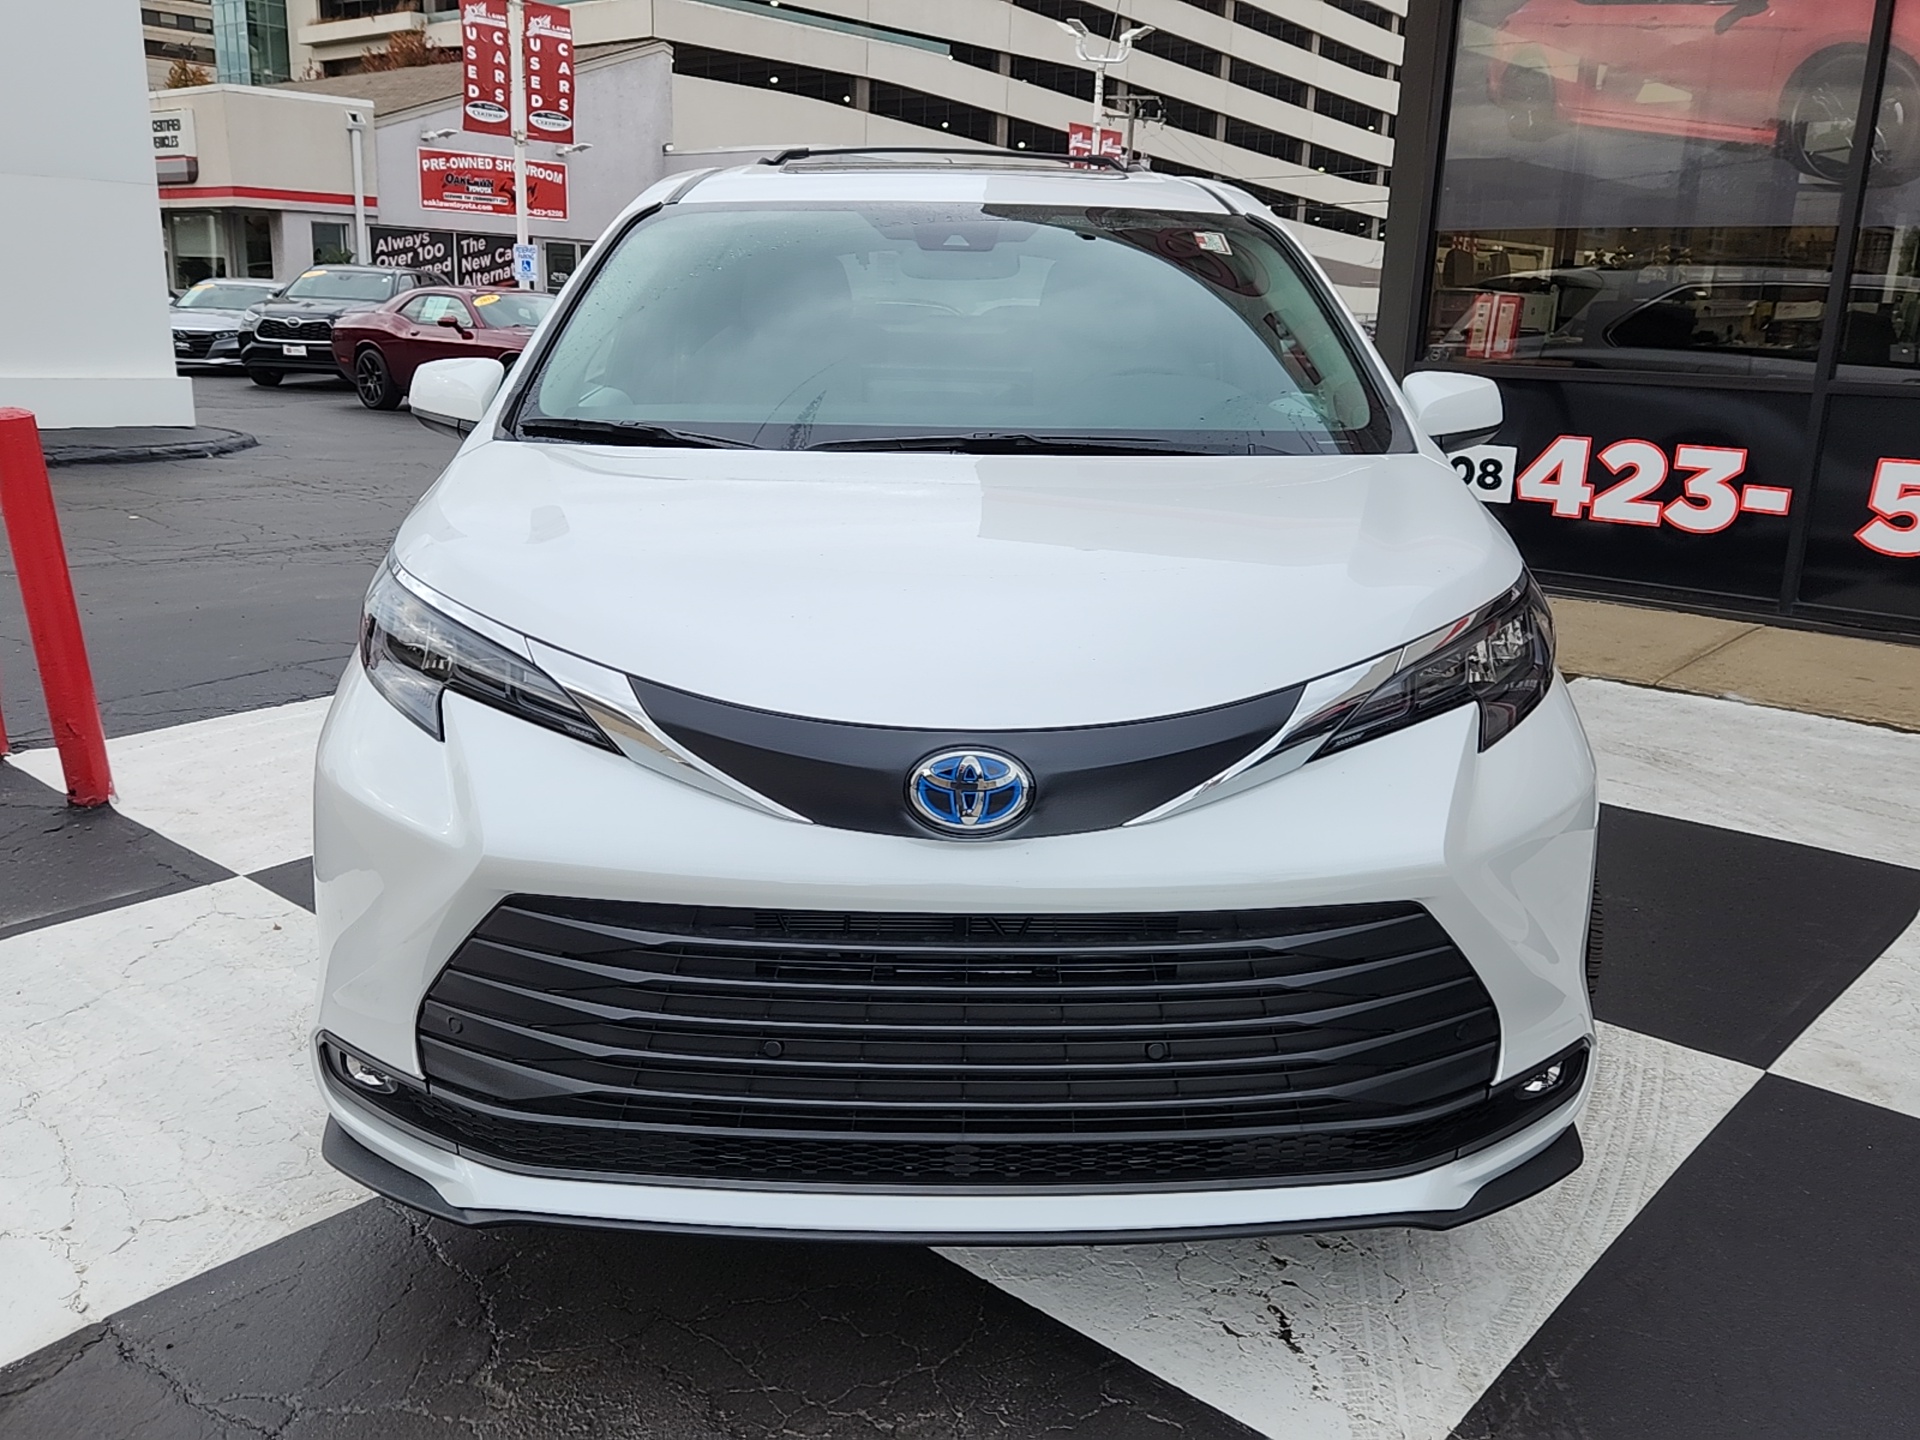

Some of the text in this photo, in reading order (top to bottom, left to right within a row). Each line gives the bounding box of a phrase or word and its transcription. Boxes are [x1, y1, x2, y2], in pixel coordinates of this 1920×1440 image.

[466, 26, 479, 98] USED
[493, 31, 506, 103] CARS
[530, 38, 543, 108] USED
[557, 43, 571, 112] CARS
[422, 157, 563, 184] PRE-OWNED SHROOM
[375, 232, 430, 254] Always
[376, 243, 445, 267] Over 100
[460, 237, 487, 255] The
[462, 247, 512, 273] New Ca
[464, 262, 516, 286] Alternat
[1450, 435, 1920, 558] 08 423- 5
